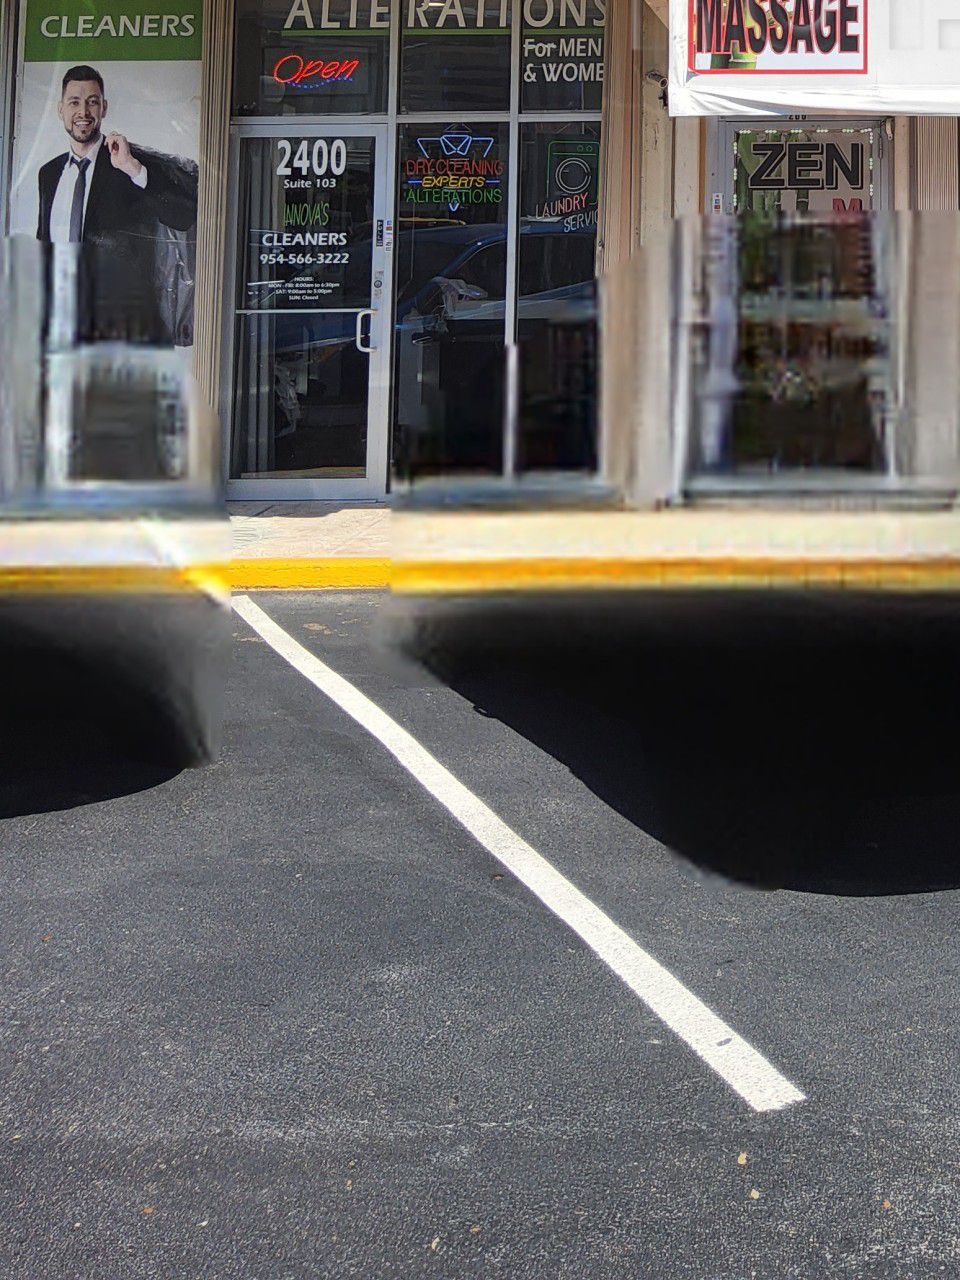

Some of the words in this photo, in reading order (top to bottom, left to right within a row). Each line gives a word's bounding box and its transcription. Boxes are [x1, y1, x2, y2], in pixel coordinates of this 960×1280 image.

[41, 14, 196, 39] CLEANERS
[523, 38, 557, 58] For
[558, 38, 603, 57] MEN
[273, 54, 360, 84] Open
[523, 63, 537, 83] &
[276, 138, 348, 177] 2400
[749, 141, 864, 191] ZEN
[283, 178, 312, 189] Suite
[315, 178, 337, 189] 103
[421, 175, 486, 188] EXPERTS
[406, 189, 503, 204] ALTERATIONS
[535, 192, 590, 220] LAUNDRY
[284, 200, 330, 227] INNOVA'S
[262, 231, 348, 247] CLEANERS
[259, 252, 350, 265] 954-566-3222
